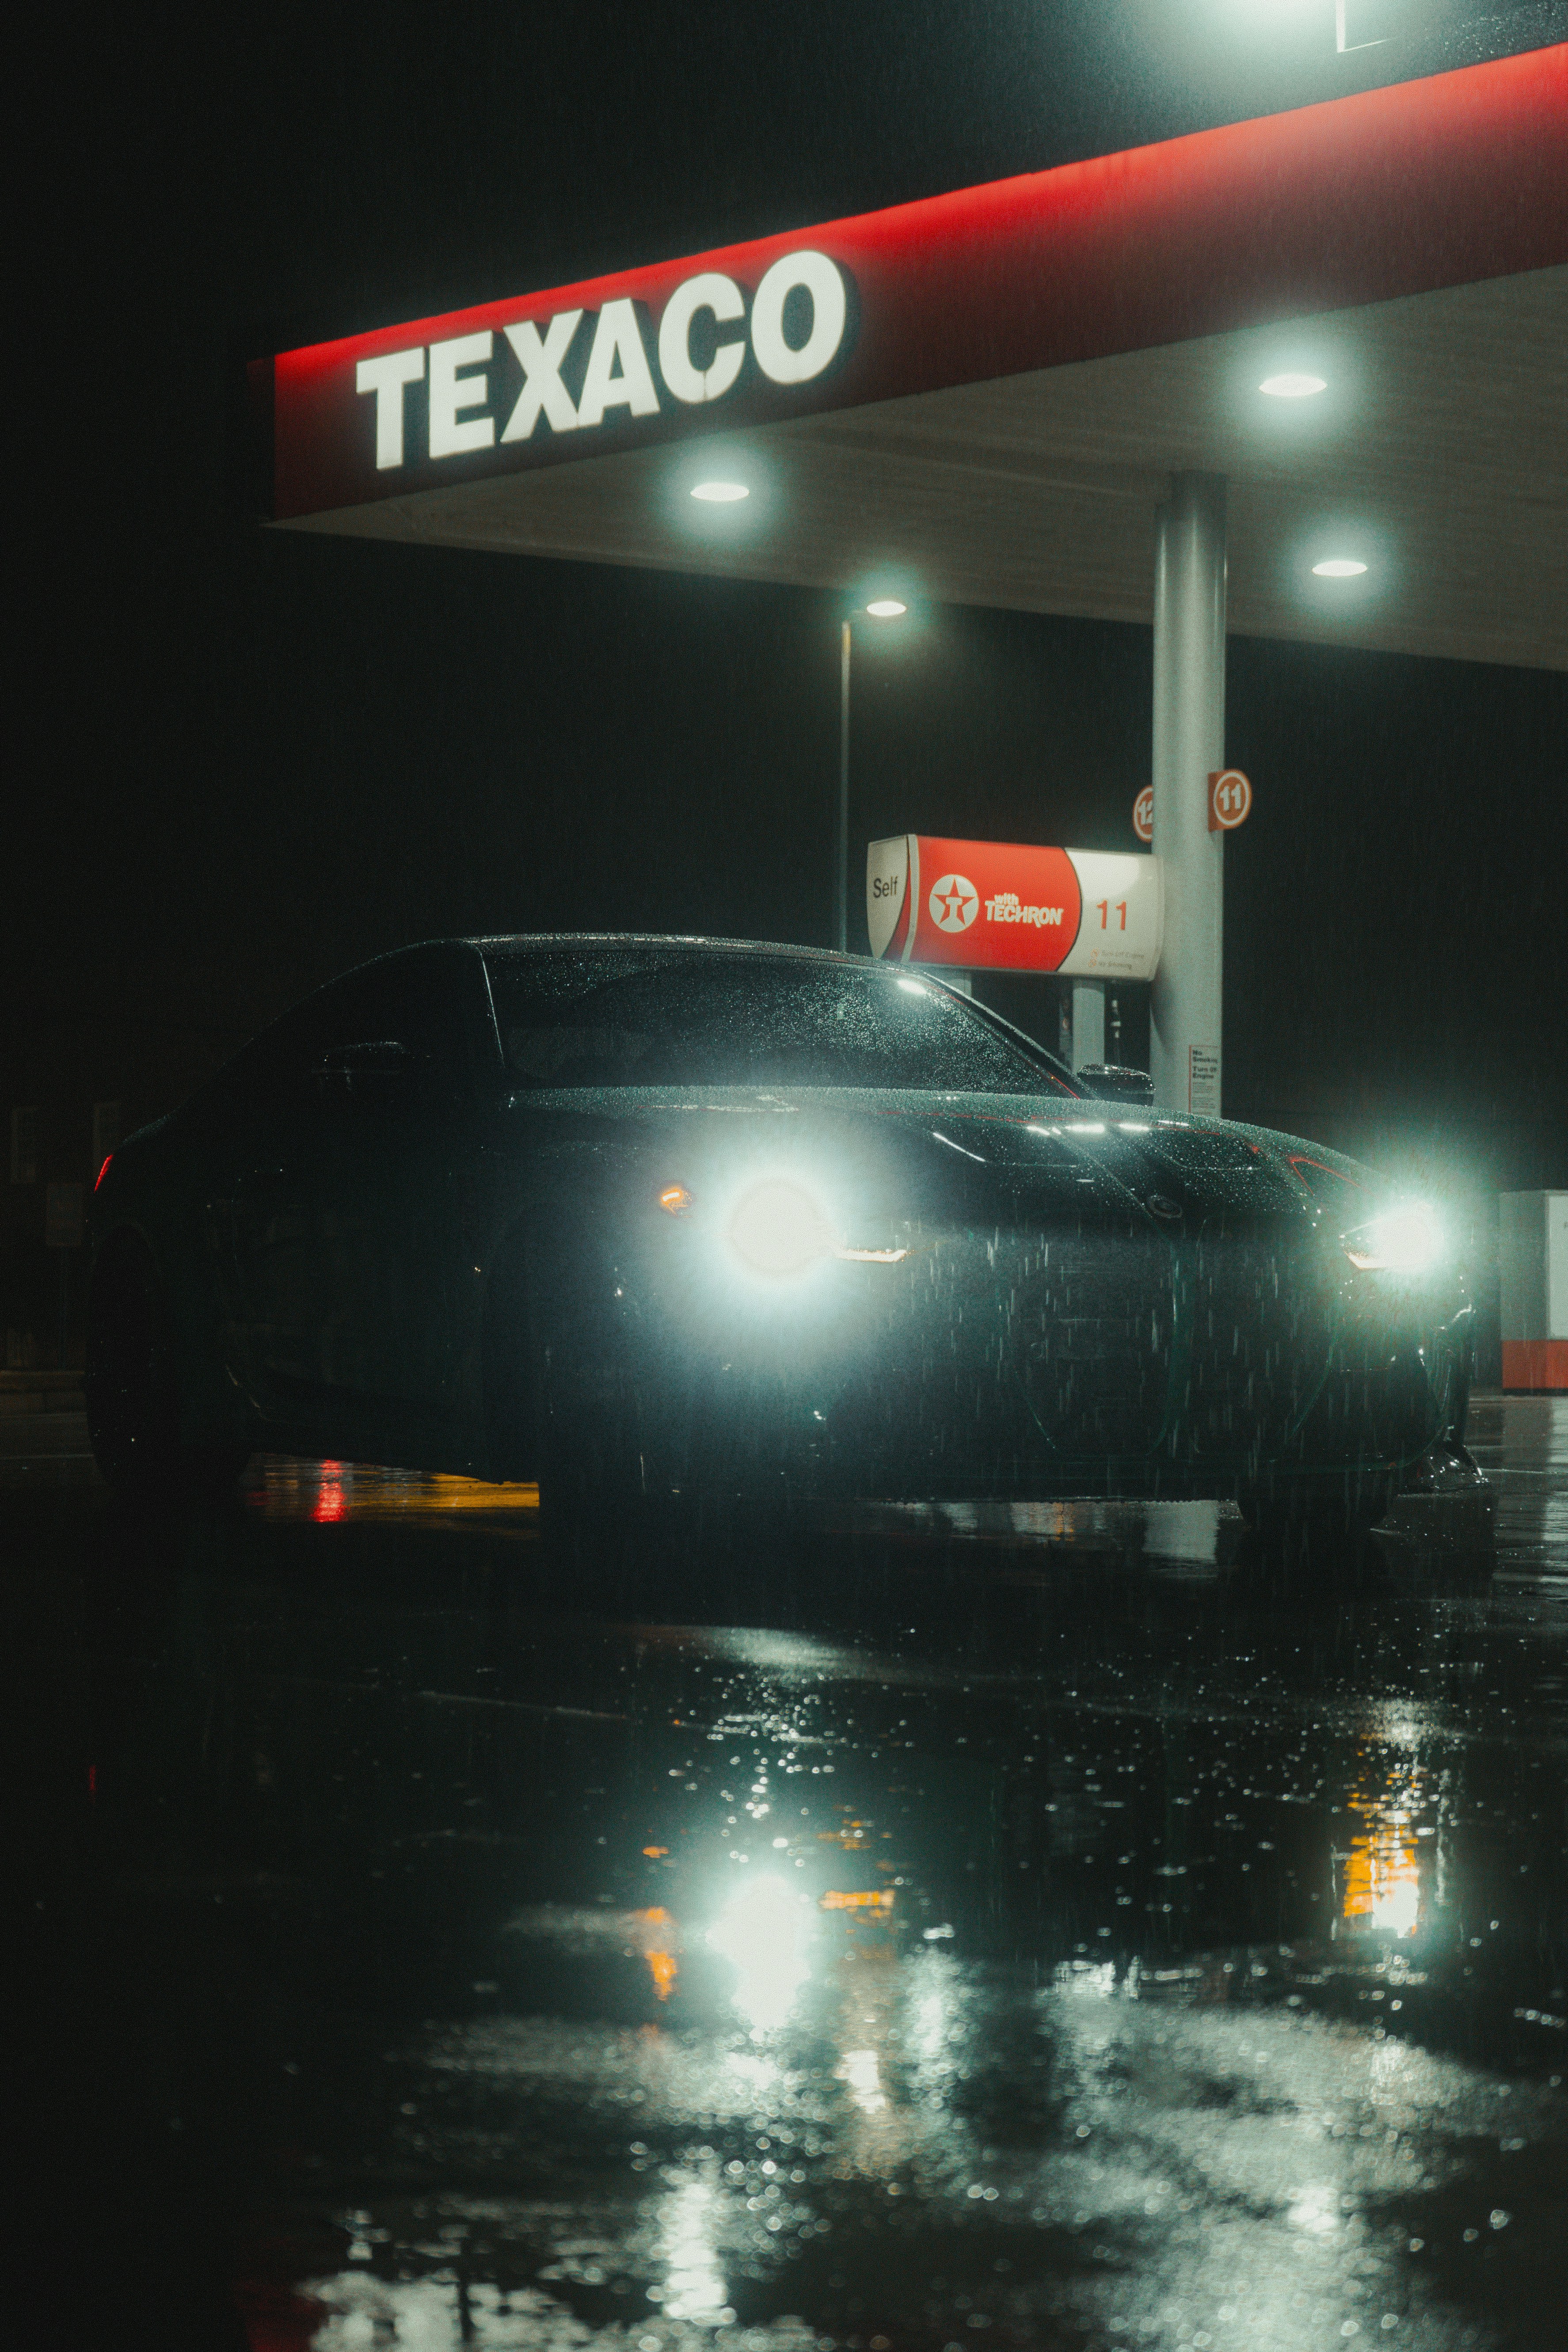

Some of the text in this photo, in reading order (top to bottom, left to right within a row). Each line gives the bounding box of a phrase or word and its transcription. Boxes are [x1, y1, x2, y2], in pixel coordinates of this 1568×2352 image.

[356, 249, 846, 470] TEXACO
[1219, 784, 1241, 811] 11
[873, 876, 898, 898] Self
[994, 892, 1019, 905] with
[985, 900, 1064, 928] TECHRON
[1096, 899, 1127, 930] 11
